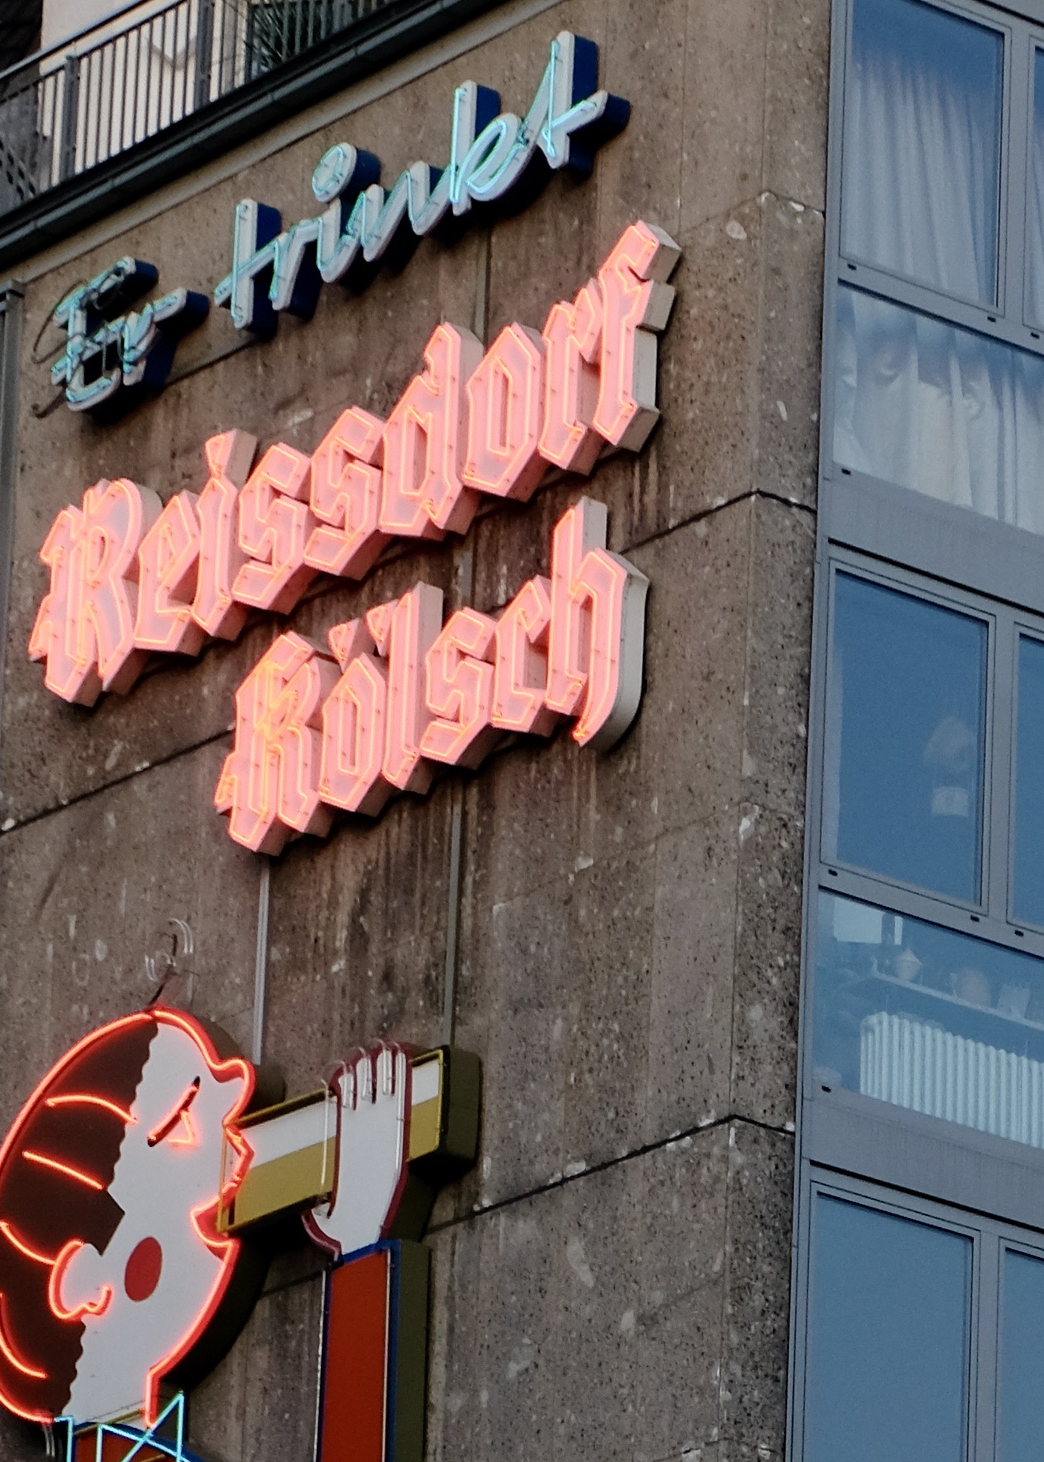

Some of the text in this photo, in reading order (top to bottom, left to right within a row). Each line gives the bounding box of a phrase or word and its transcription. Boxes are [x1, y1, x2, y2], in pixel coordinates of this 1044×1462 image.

[214, 30, 610, 331] trinkt
[29, 220, 670, 704] Reissdorf
[214, 498, 644, 853] Kölsch
